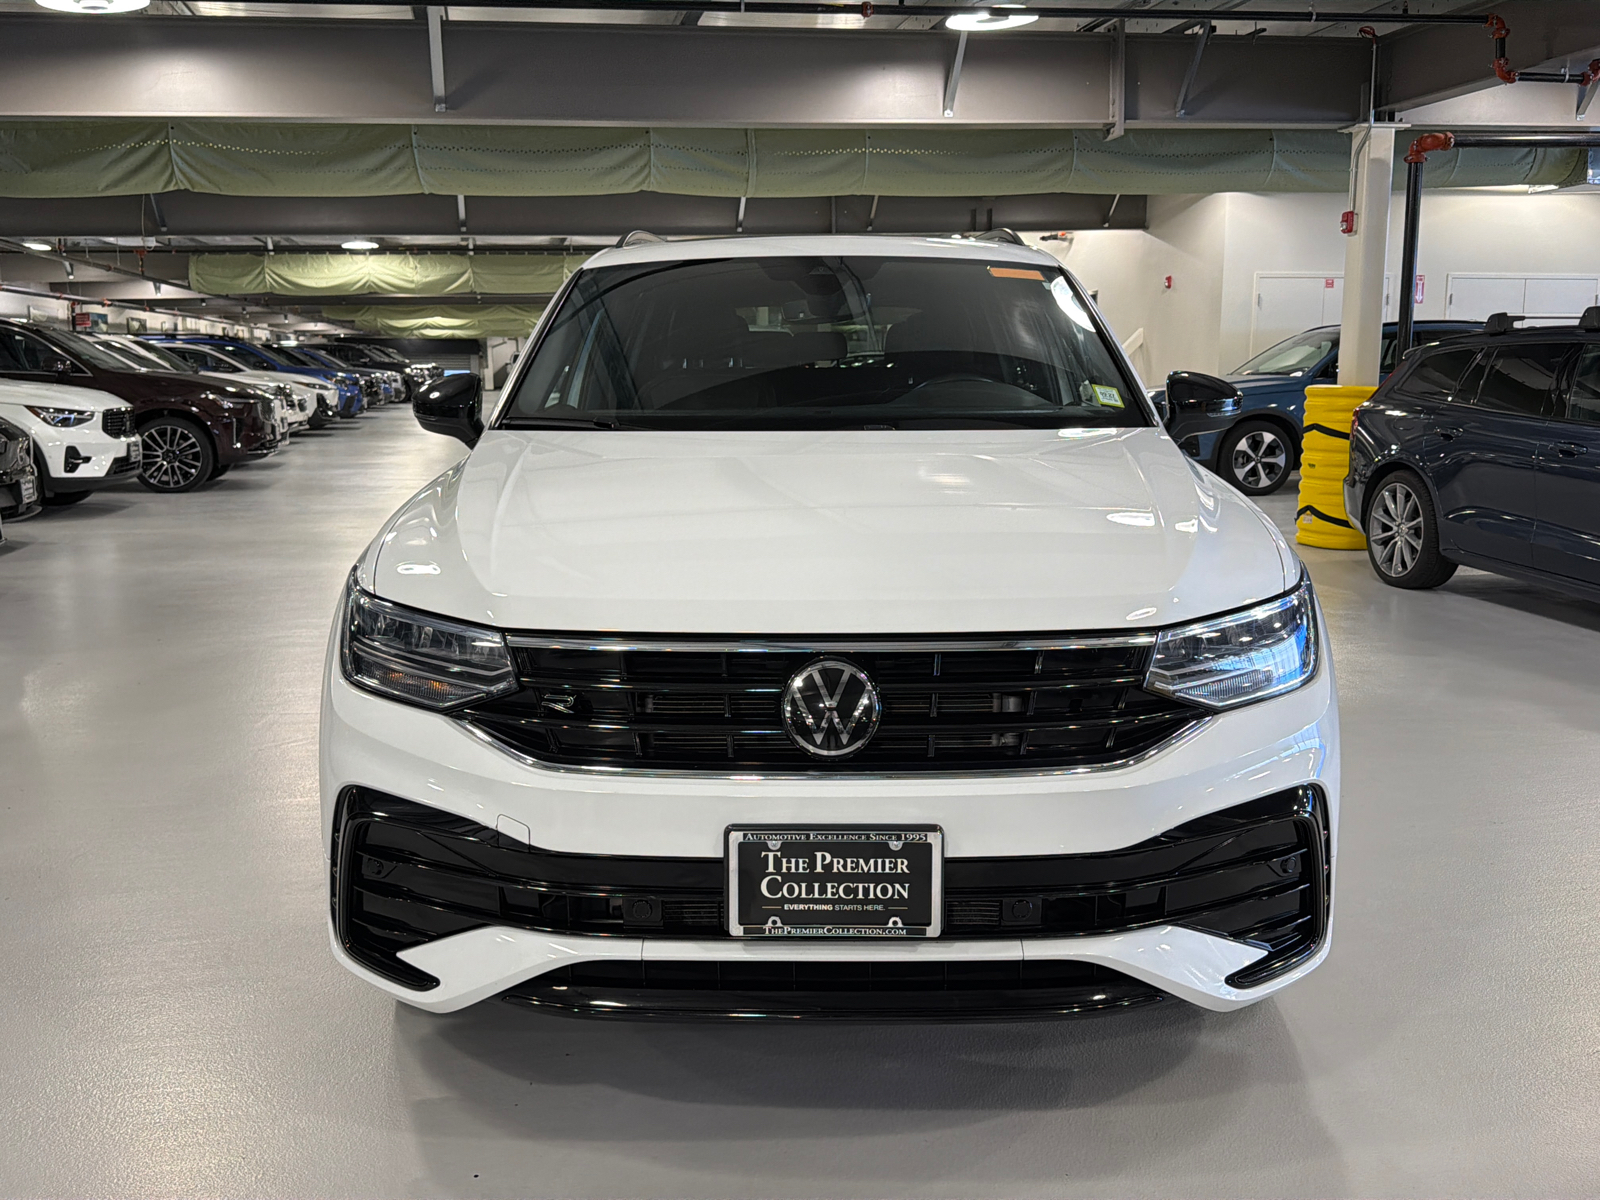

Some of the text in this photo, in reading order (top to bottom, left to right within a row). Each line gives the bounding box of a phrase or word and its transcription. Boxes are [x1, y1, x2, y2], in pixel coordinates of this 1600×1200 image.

[745, 833, 926, 841] AUTOMOTIVE EXCELLENCE SINCE 1995
[761, 851, 910, 873] THE PREMIER
[760, 875, 910, 899] COLLECTION
[784, 903, 833, 911] EVERYTHING
